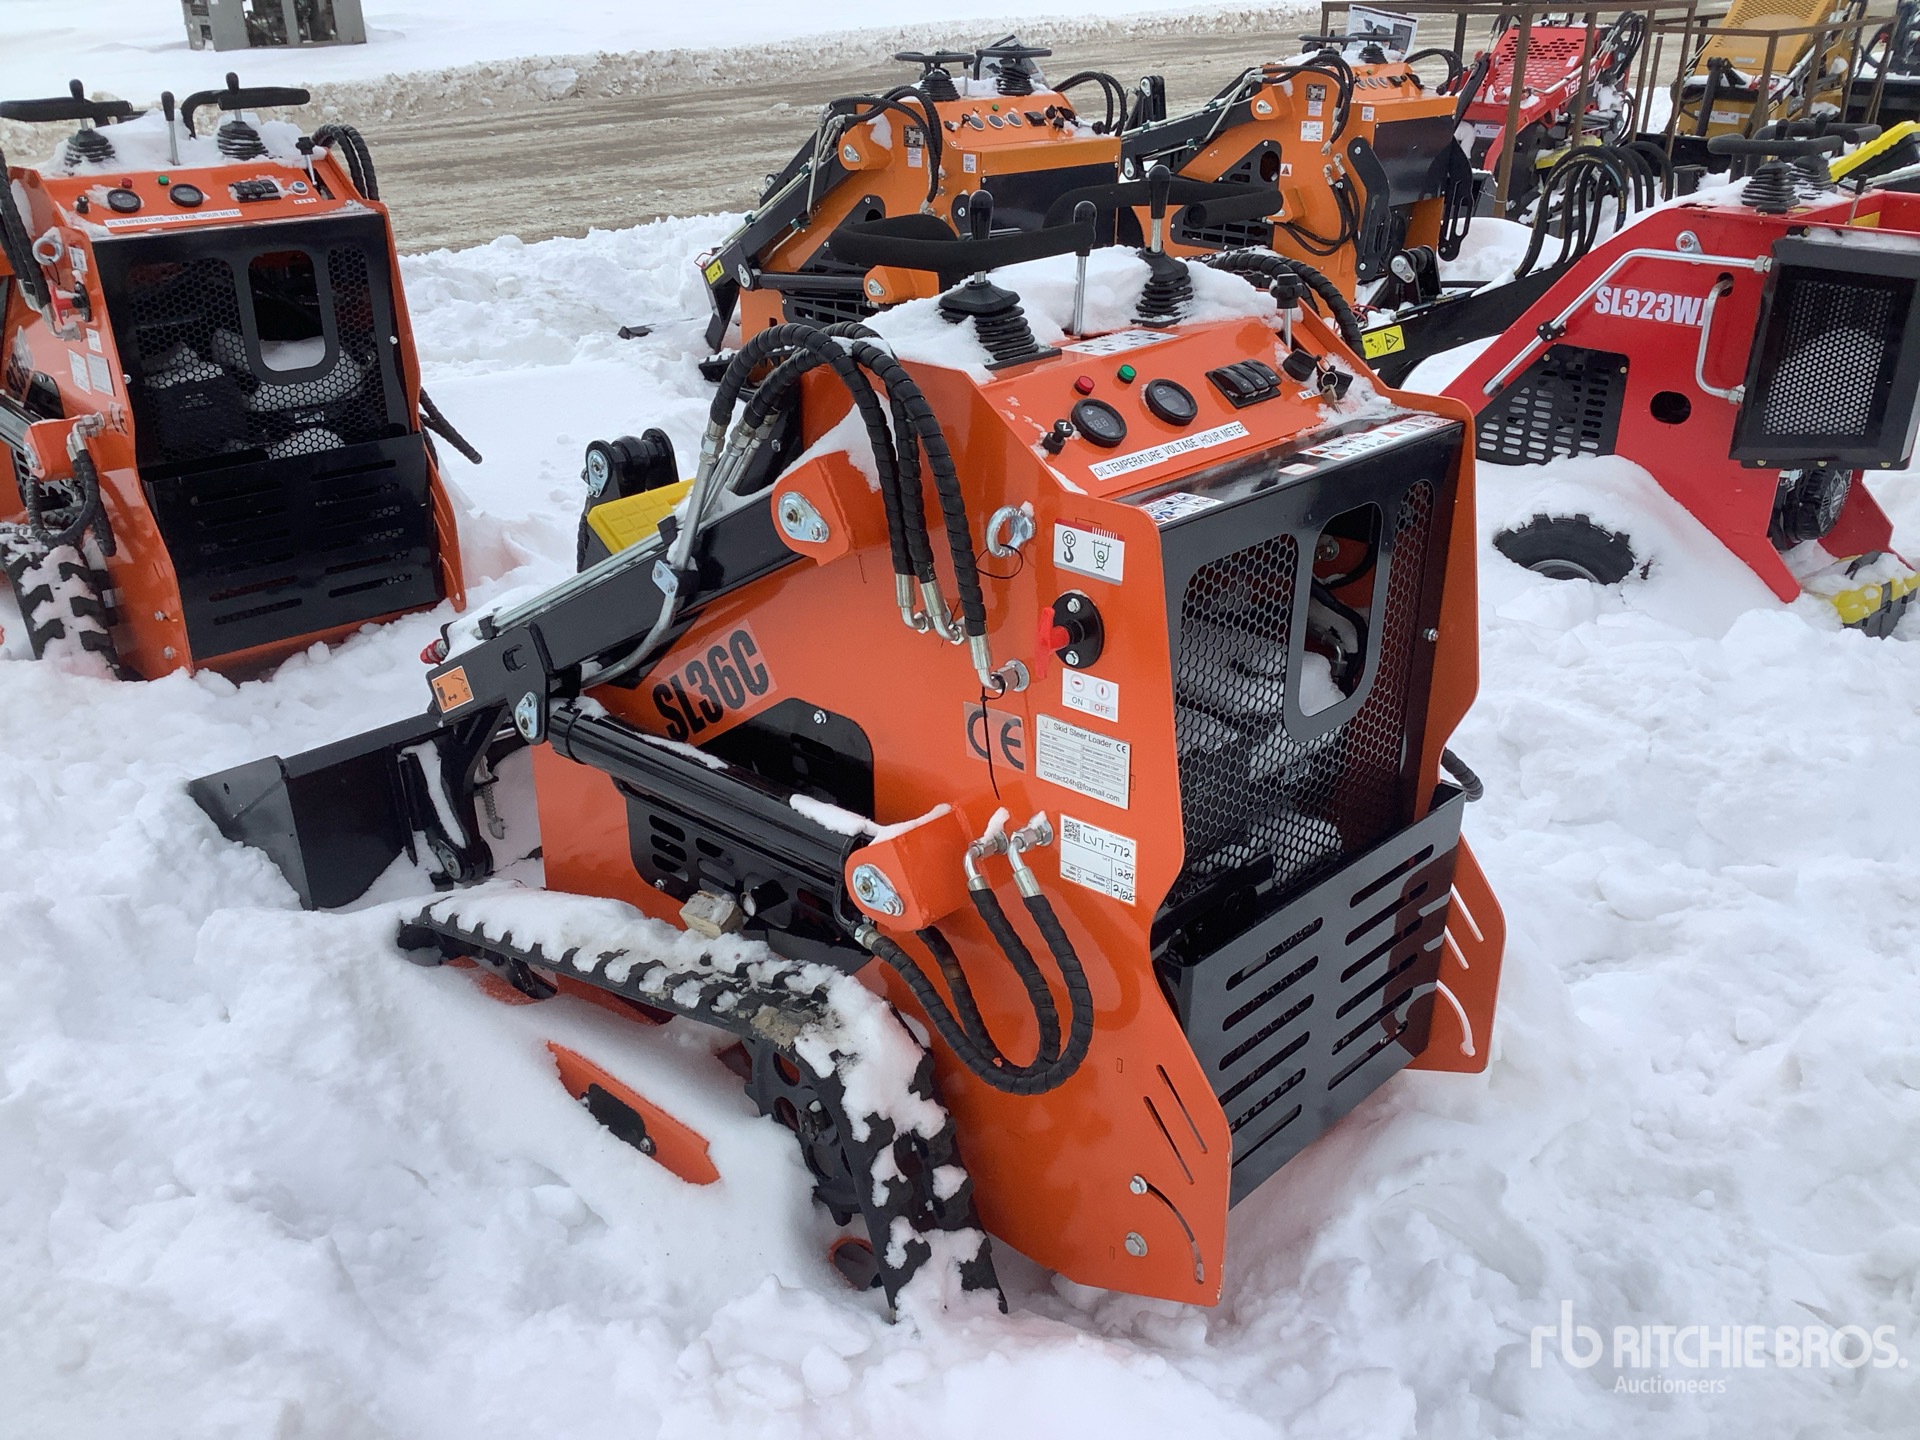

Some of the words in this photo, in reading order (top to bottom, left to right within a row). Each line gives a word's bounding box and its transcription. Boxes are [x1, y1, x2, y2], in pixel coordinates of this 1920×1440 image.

[1162, 438, 1197, 456] VOLTAGE
[1199, 431, 1222, 445] HOUR
[652, 629, 769, 743] SL36C
[1071, 696, 1083, 706] ON
[1094, 703, 1110, 714] OFF
[1053, 722, 1068, 734] Skid
[1069, 728, 1087, 740] Steer
[1088, 734, 1112, 749] Loader
